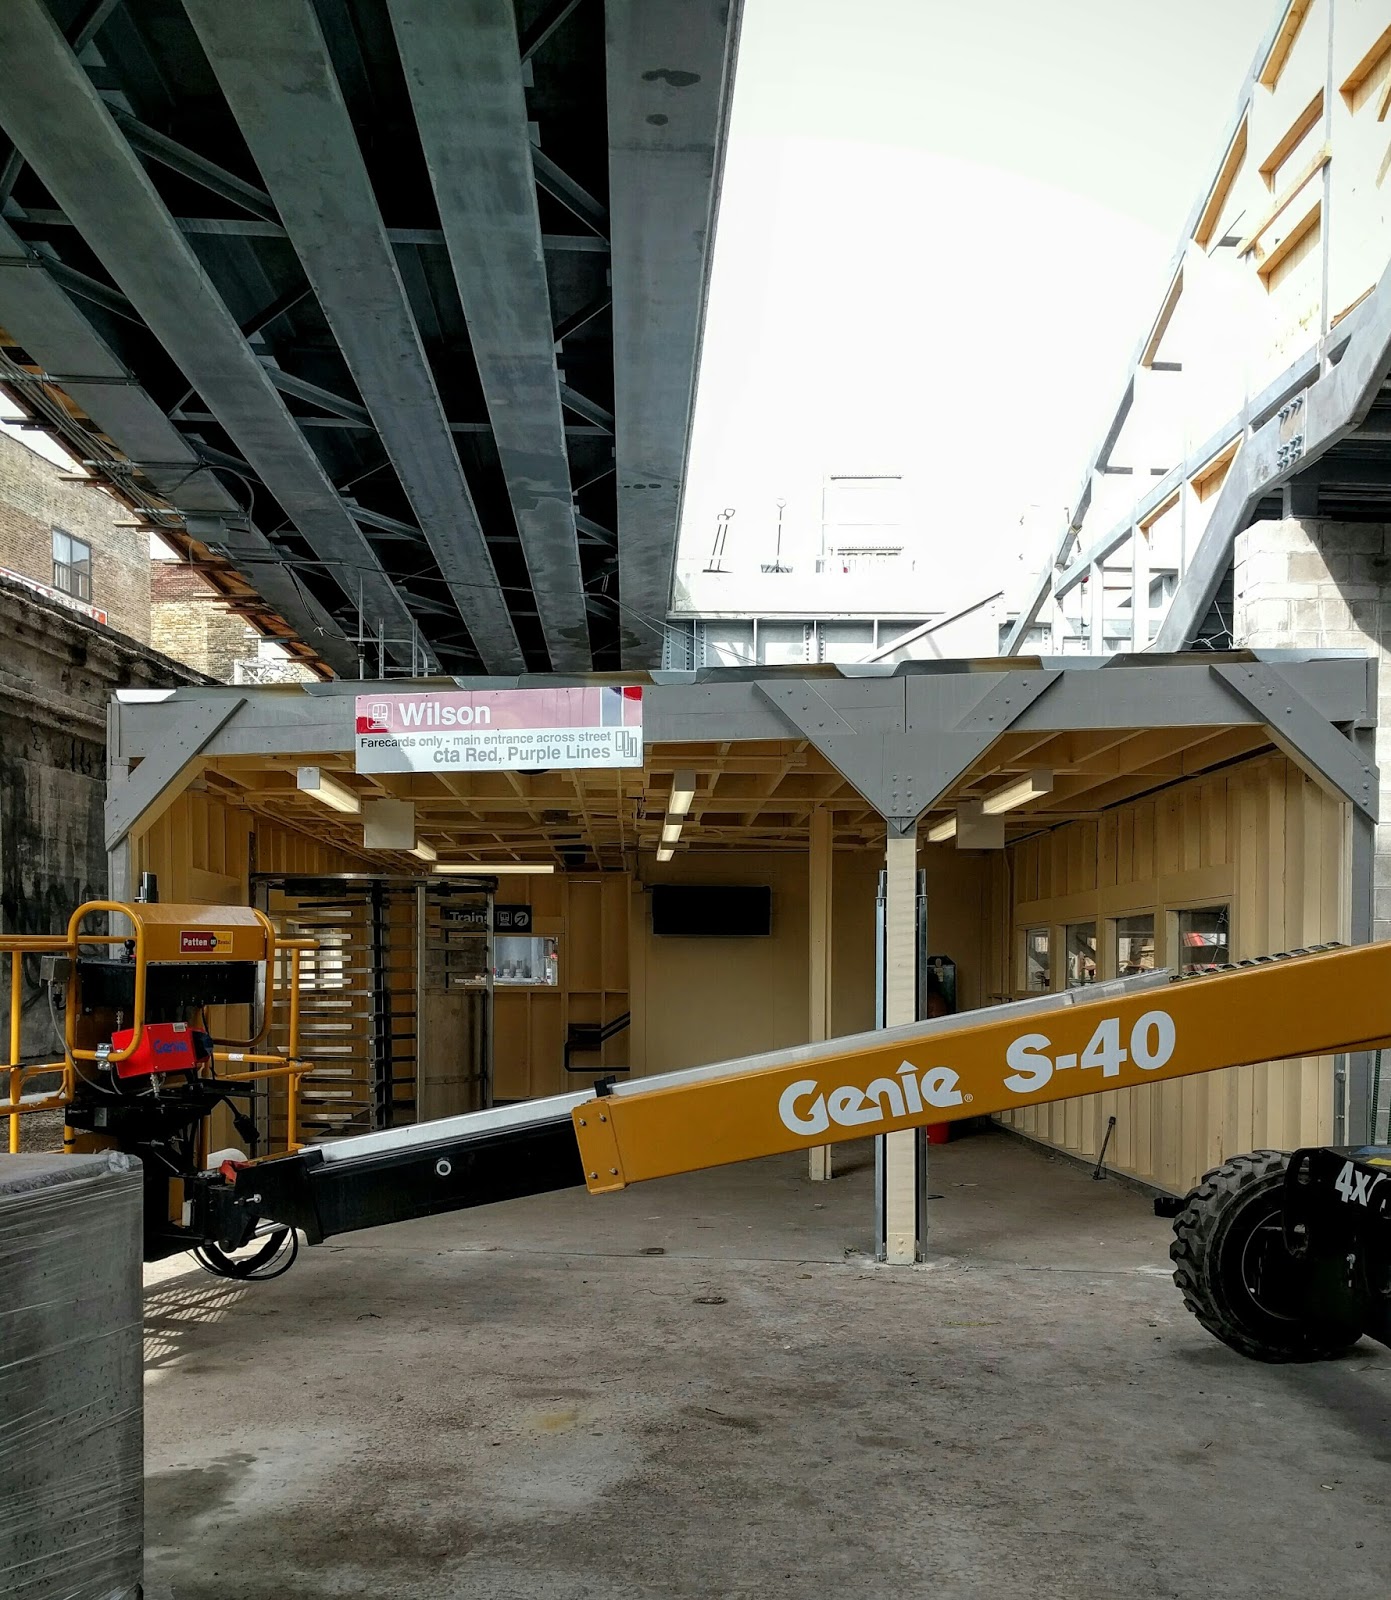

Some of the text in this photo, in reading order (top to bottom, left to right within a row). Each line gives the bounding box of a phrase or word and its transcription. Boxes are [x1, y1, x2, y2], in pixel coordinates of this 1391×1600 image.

[399, 701, 491, 727] Wilson
[361, 735, 416, 748] Farecards
[418, 735, 443, 748] only
[453, 734, 481, 746] main
[483, 733, 534, 746] entrance
[536, 733, 574, 744] across
[577, 731, 612, 743] street
[433, 743, 611, 764] cta Red, Purple Lines
[183, 937, 208, 946] Patten
[778, 1010, 1176, 1136] Genie S-40
